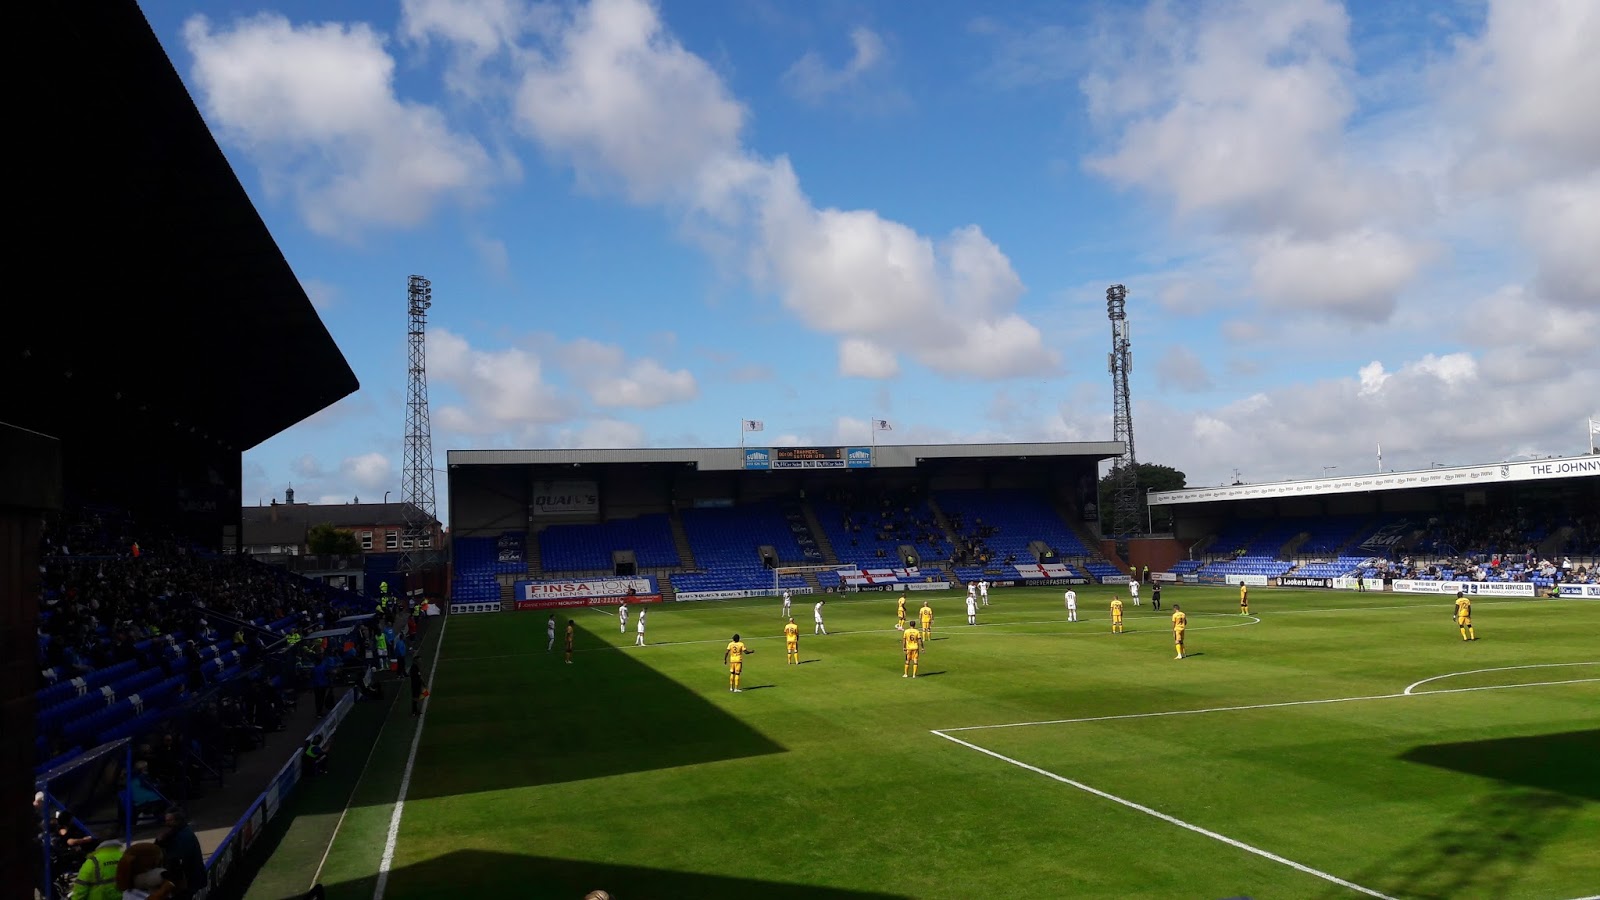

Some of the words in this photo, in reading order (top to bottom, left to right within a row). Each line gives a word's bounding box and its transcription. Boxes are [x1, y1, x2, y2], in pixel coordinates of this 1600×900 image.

[747, 452, 768, 460] SUMMIT
[849, 451, 870, 459] SUMMIT
[1531, 465, 1552, 474] THE
[531, 583, 590, 593] FINSA
[592, 580, 644, 590] HOME
